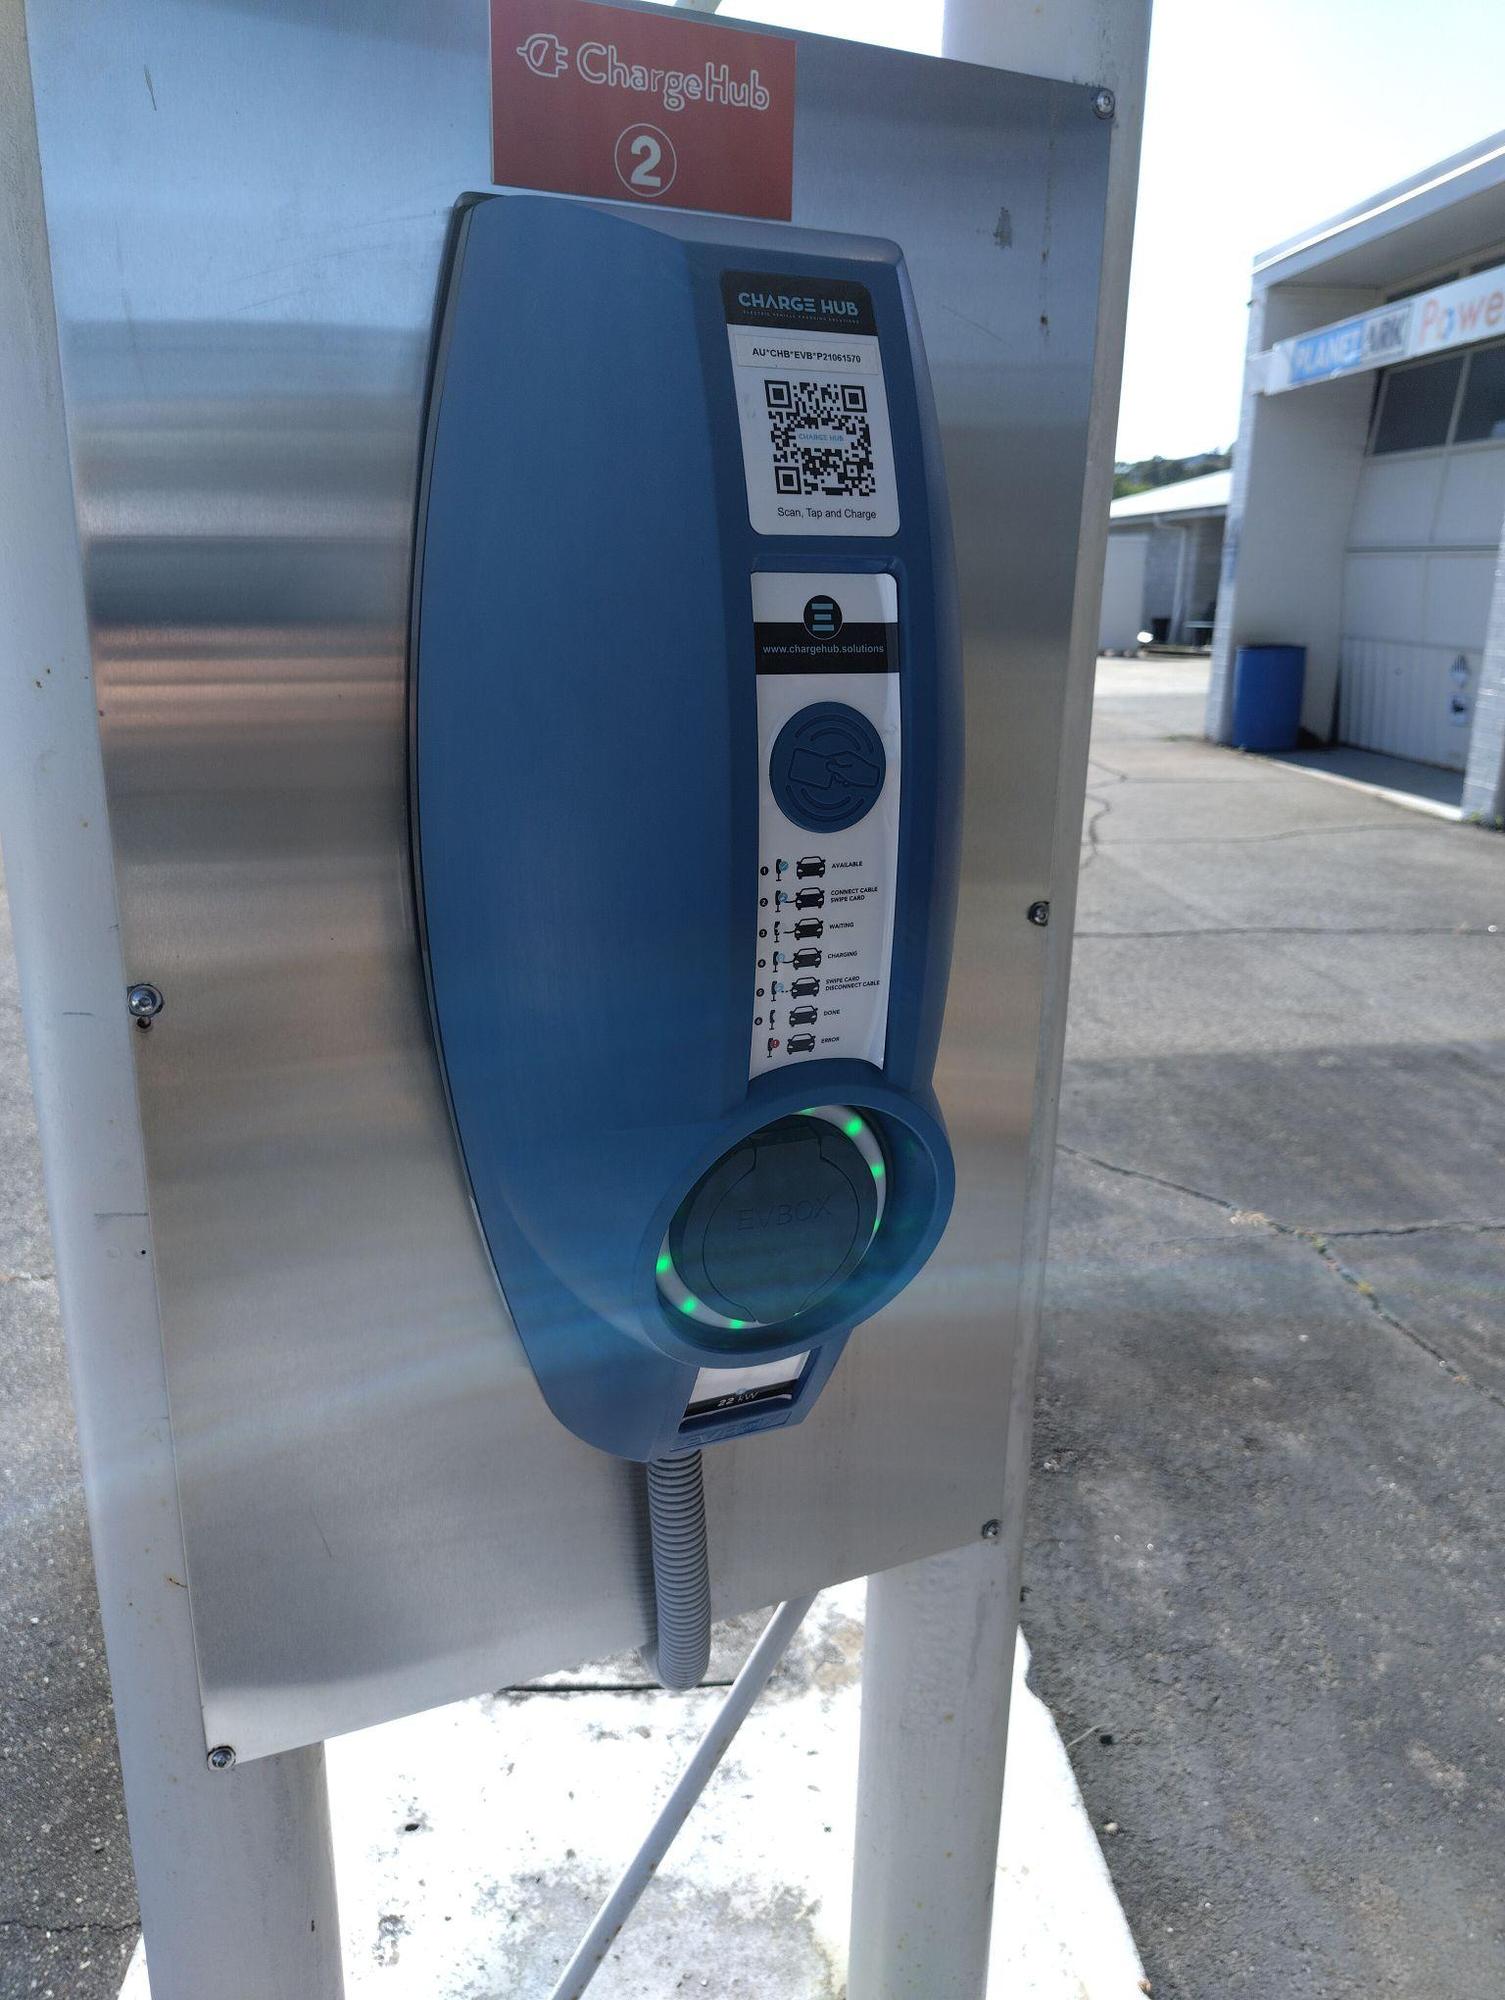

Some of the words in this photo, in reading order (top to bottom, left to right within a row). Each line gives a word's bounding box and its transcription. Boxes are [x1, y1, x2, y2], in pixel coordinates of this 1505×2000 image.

[576, 41, 770, 111] ChargeHub
[630, 135, 661, 187] 2
[738, 292, 816, 313] CHARGE
[820, 299, 859, 316] HUB
[777, 507, 803, 518] Scan,
[806, 508, 822, 520] Tap
[825, 509, 842, 518] and
[844, 509, 877, 520] Charge
[763, 643, 884, 655] www.chargehub.solutions
[831, 861, 863, 869] AVAILABLE
[830, 888, 859, 896] CONNECT
[827, 951, 858, 959] CHARGING
[825, 982, 862, 991] DISCONNECT
[736, 1194, 832, 1231] EVBOX
[718, 1397, 735, 1407] 22
